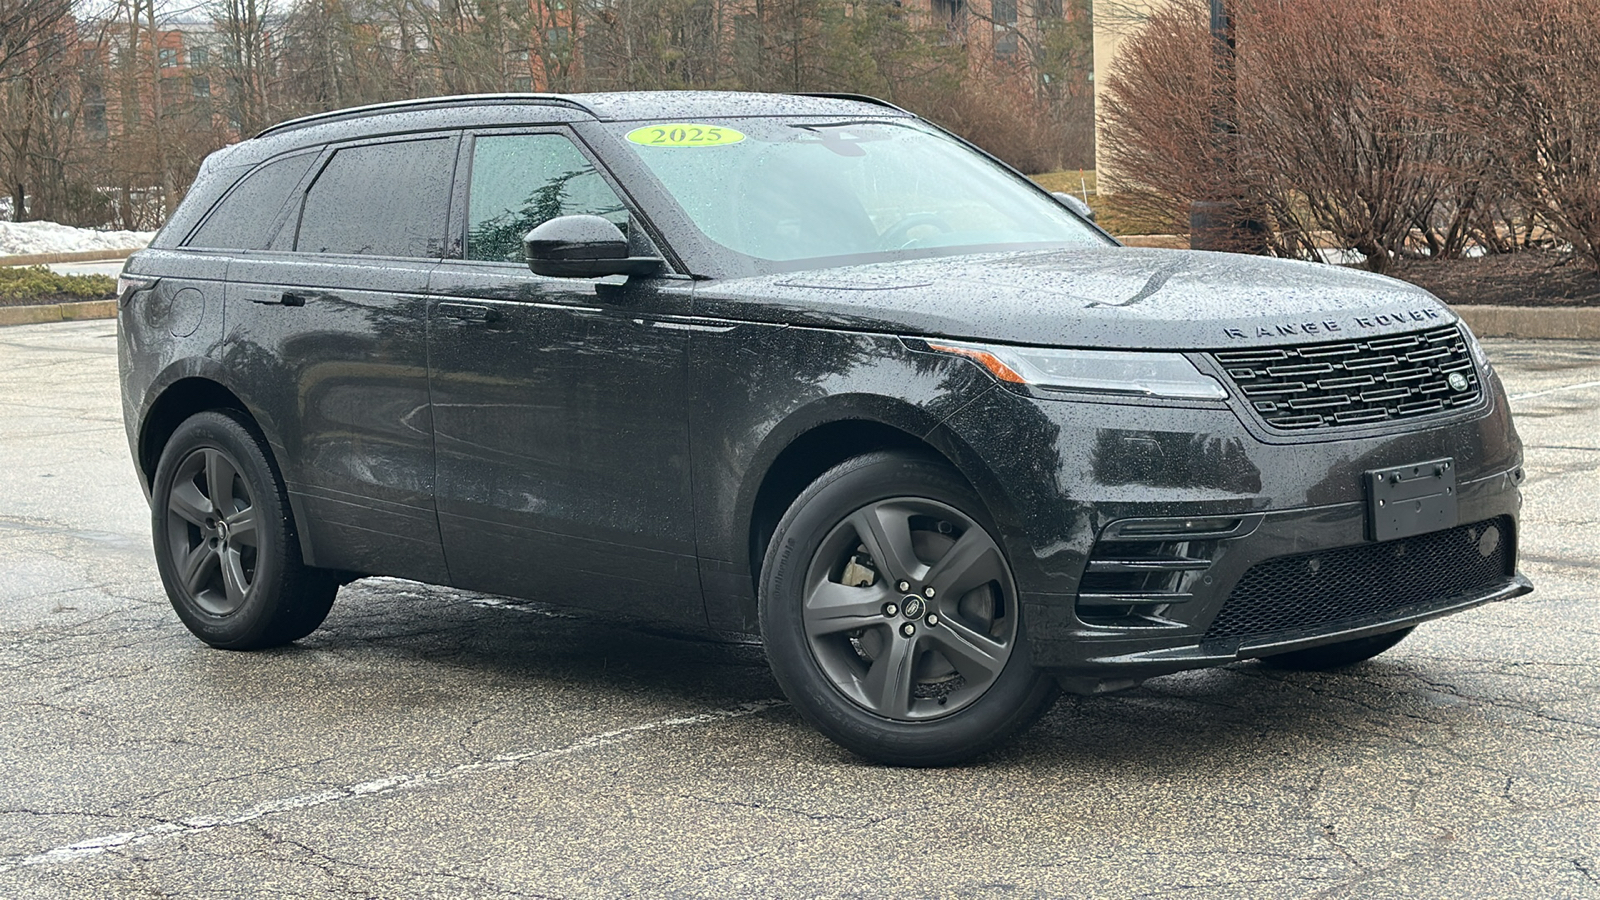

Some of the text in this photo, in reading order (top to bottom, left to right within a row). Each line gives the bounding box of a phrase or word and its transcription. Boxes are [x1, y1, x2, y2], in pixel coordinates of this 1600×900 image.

[651, 128, 722, 143] 2025
[1223, 309, 1439, 339] RANGE ROVER
